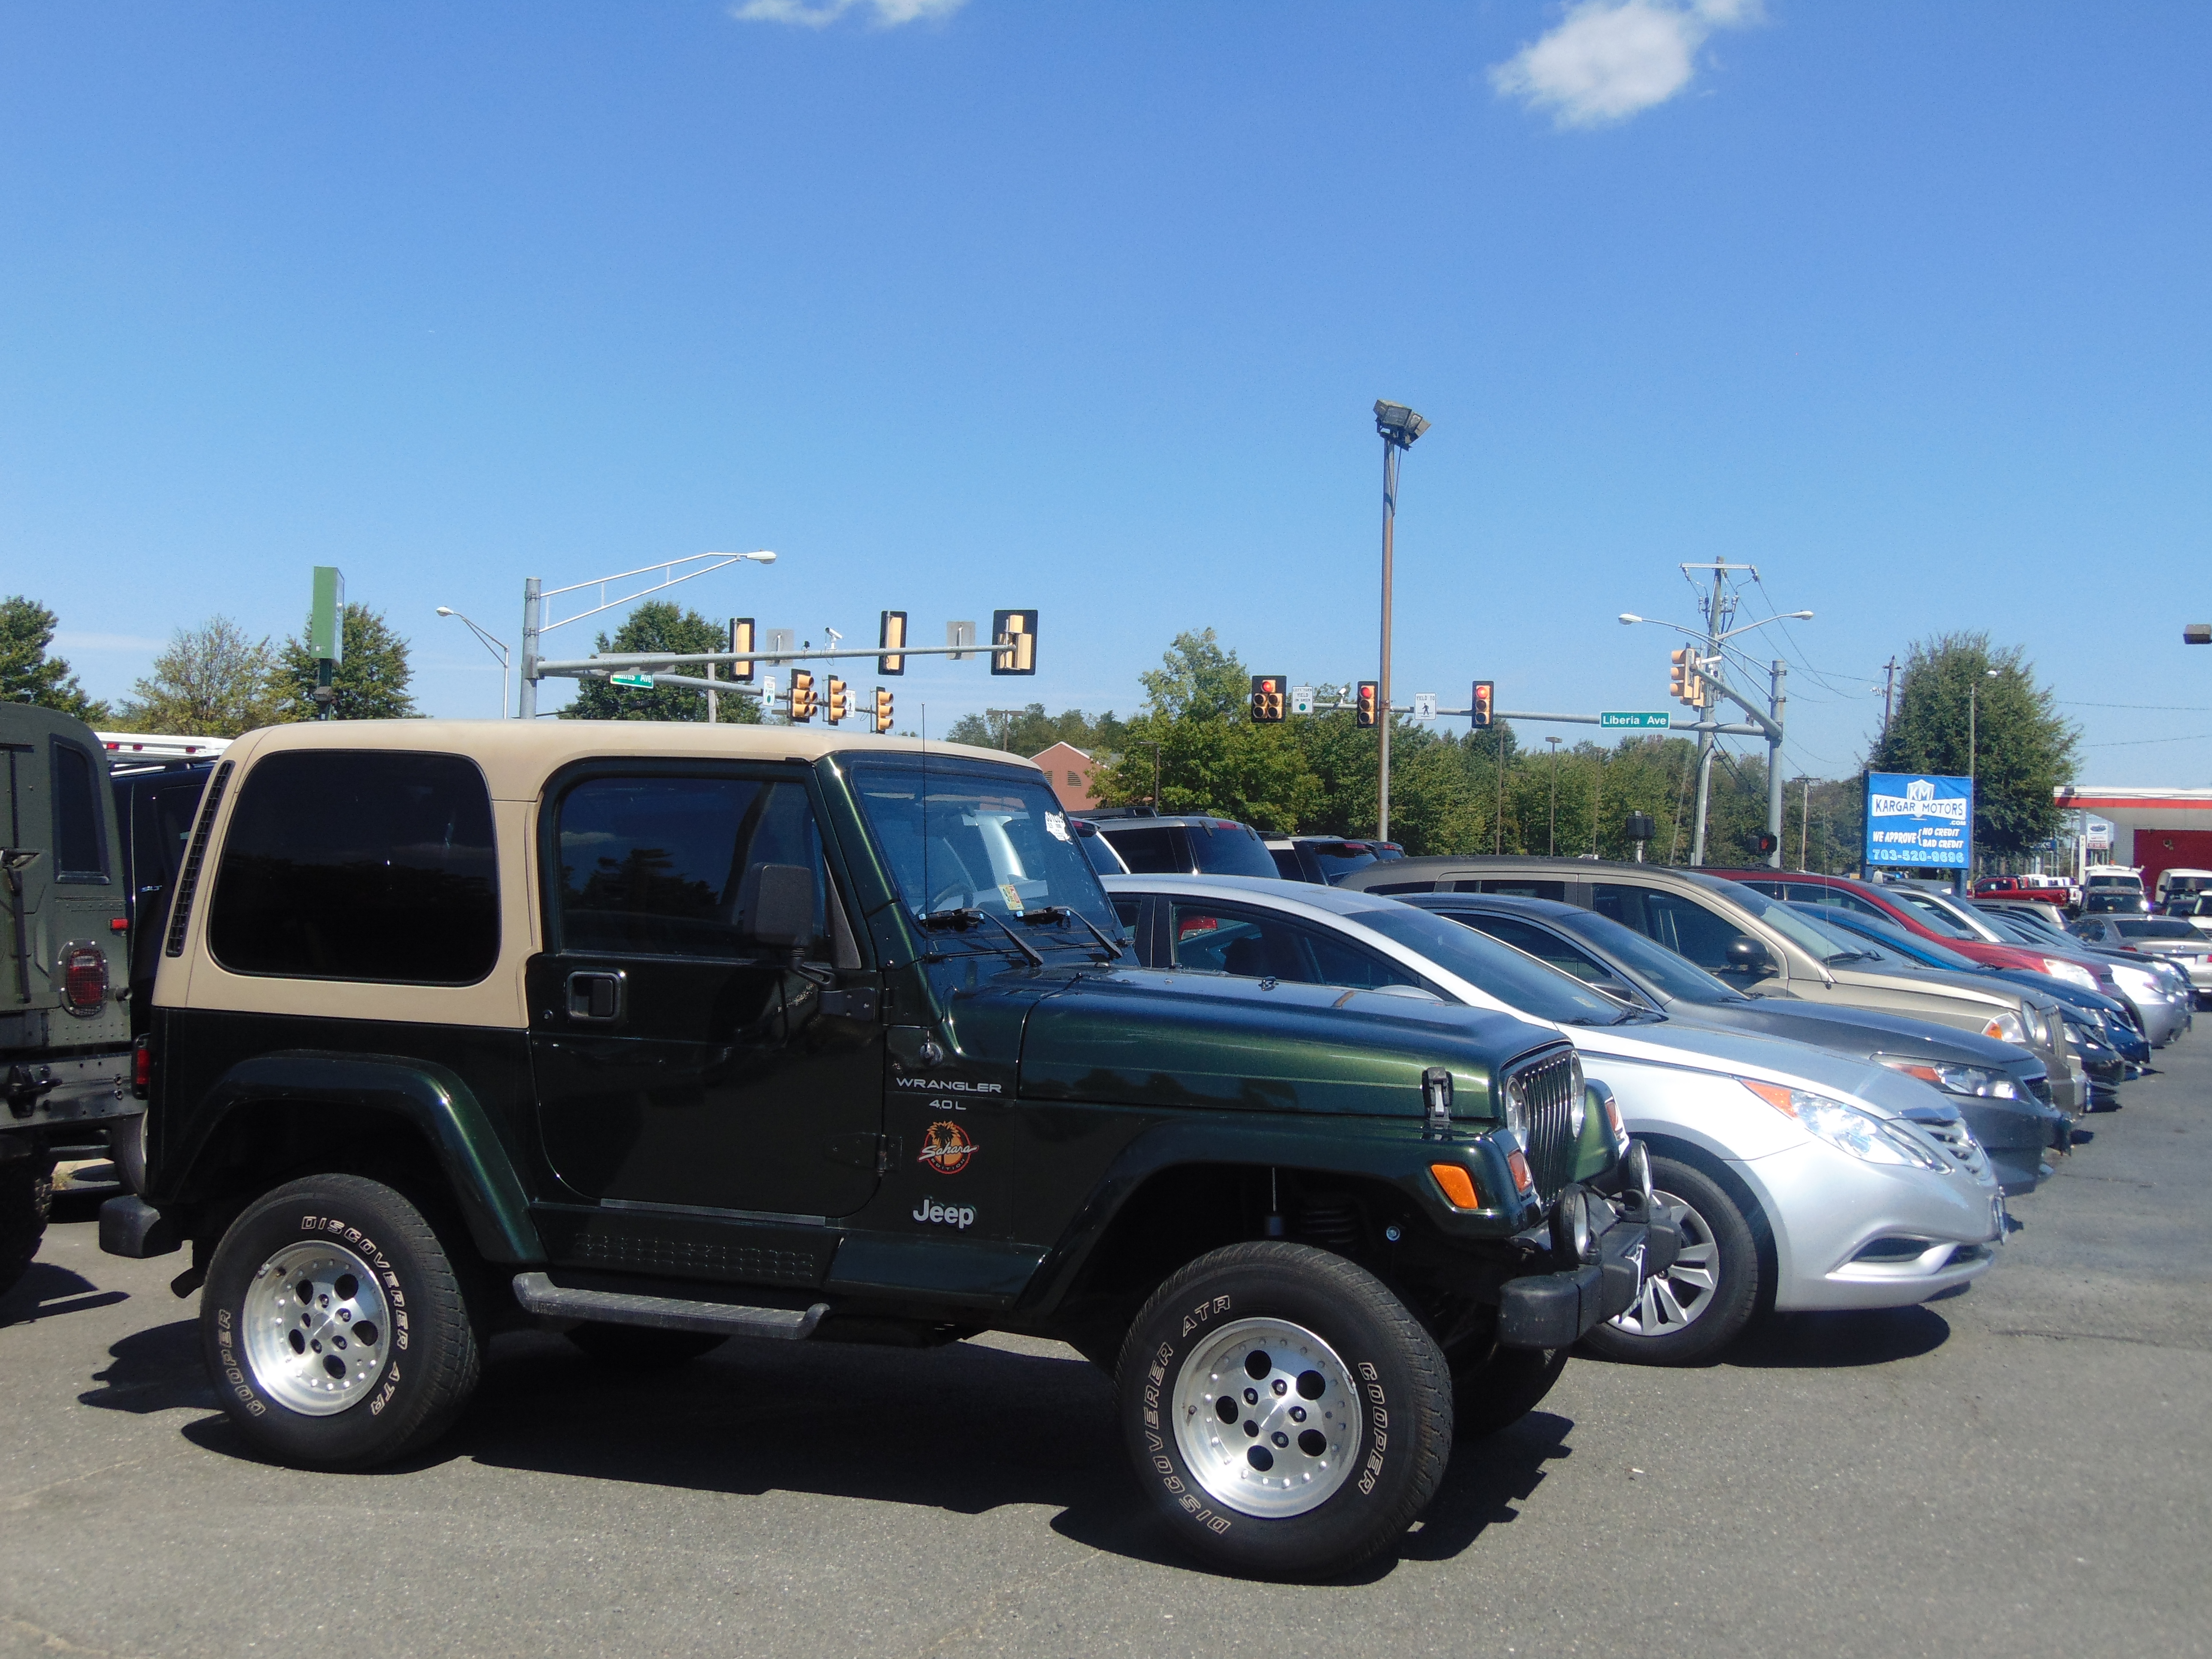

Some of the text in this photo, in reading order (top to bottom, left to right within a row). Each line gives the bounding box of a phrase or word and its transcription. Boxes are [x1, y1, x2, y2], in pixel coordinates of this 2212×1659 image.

[1602, 716, 1667, 725] Liberia Ave
[1910, 786, 1931, 801] KM
[1875, 799, 1963, 816] KARGAR MOTORS
[1873, 831, 1917, 844] WE APPROVE
[1922, 827, 1960, 837] NO CREDIT
[1922, 839, 1964, 848] BAD CREDIT
[1872, 849, 1964, 863] 703-520-9696
[896, 1077, 1002, 1093] WRANGLER
[918, 1141, 978, 1161] Sahara
[931, 1158, 965, 1171] EDITION
[913, 1199, 974, 1229] Jeep
[301, 1215, 409, 1416] DISCOVERER ATR
[218, 1309, 266, 1417] COOPER
[1143, 1295, 1231, 1534] DISCOVERER ATR
[1358, 1362, 1388, 1495] COOPER
